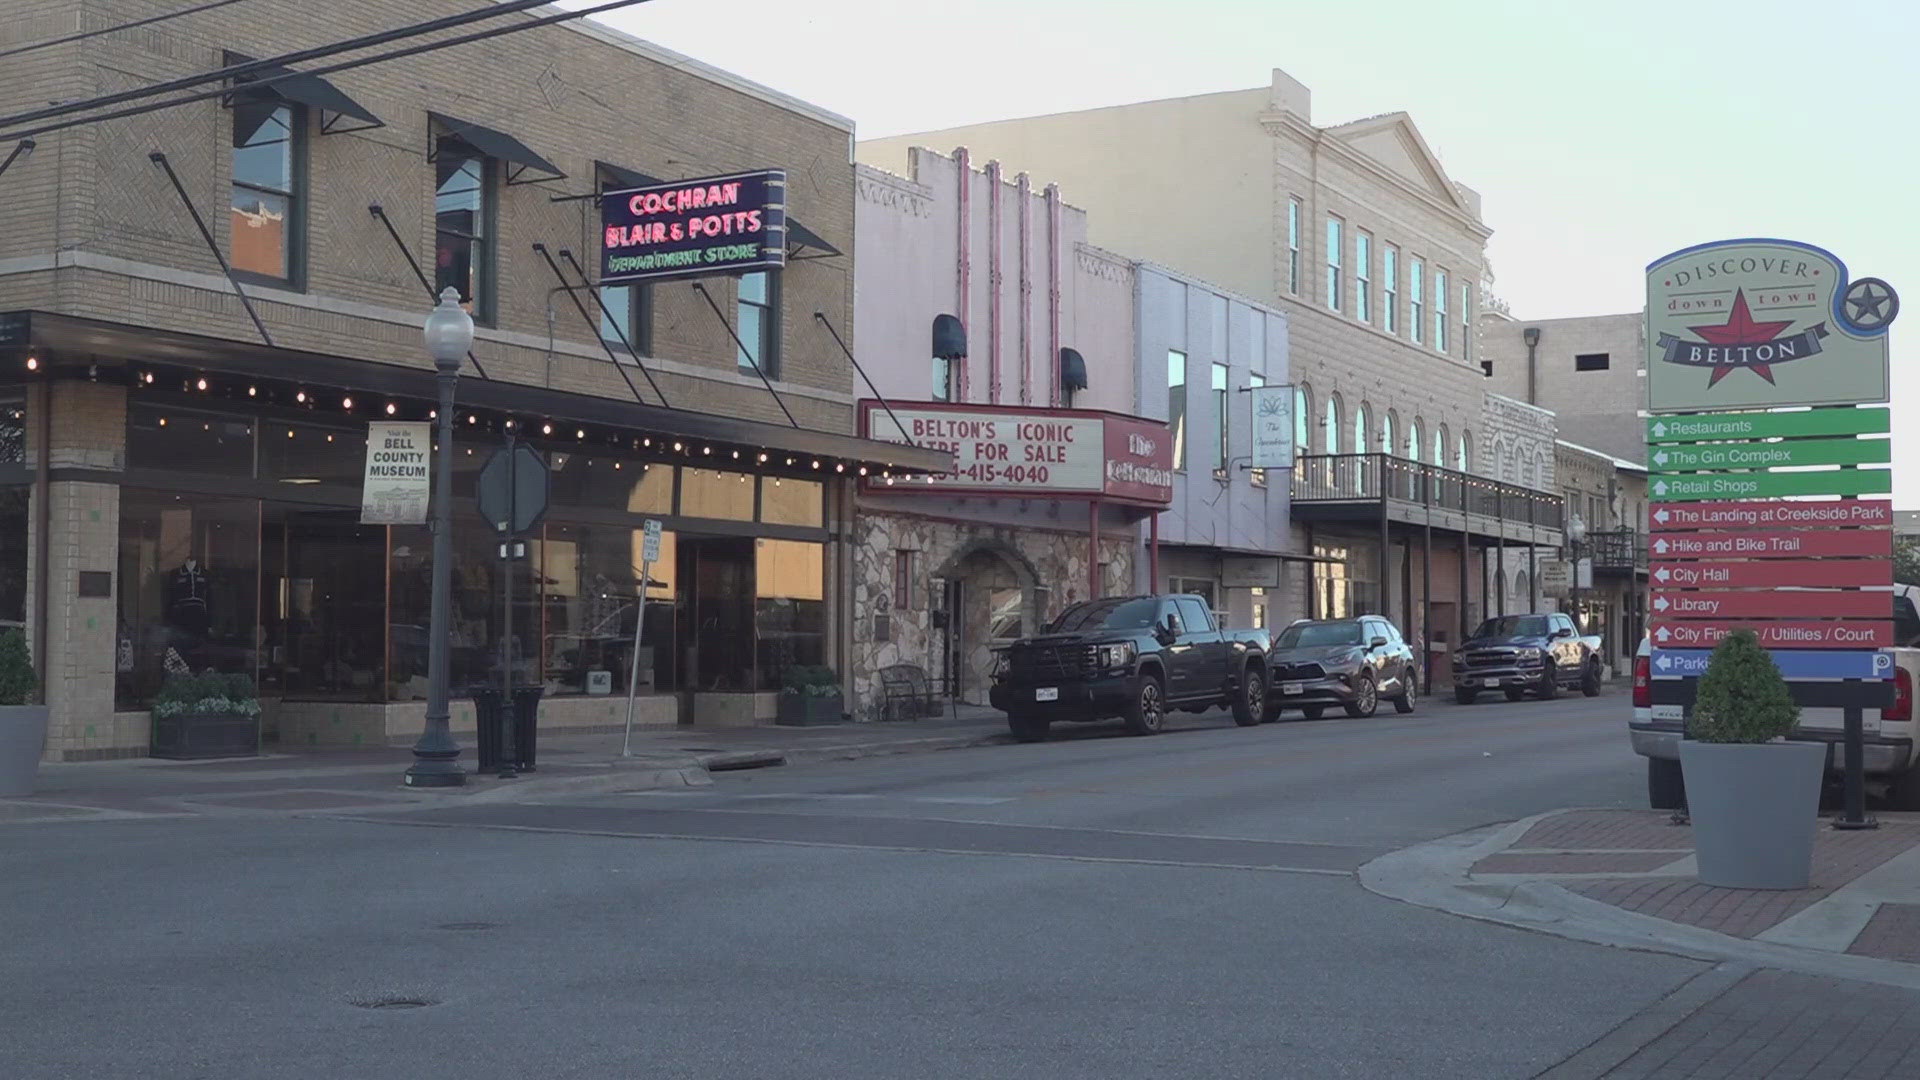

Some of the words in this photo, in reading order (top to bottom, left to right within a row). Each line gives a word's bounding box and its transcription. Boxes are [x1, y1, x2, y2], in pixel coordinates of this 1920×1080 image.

[629, 182, 741, 216] COCHRAN
[605, 222, 667, 249] BLAIR
[670, 223, 684, 241] &
[688, 210, 762, 240] POTTS
[608, 249, 702, 273] DEPARTMENT
[704, 243, 760, 264] STORE
[1675, 257, 1809, 287] DISCOVER
[1668, 297, 1723, 311] down
[1758, 291, 1816, 305] town
[1690, 340, 1796, 363] BELTON
[913, 419, 996, 439] BELTON'S
[1016, 423, 1074, 443] ICONIC
[1671, 420, 1752, 434] Restaurants
[384, 438, 415, 449] BELL
[373, 452, 424, 463] COUNTY
[975, 442, 1008, 461] FOR
[1024, 445, 1067, 463] SALE
[1671, 451, 1697, 464] The
[1701, 450, 1725, 463] Gin
[1729, 449, 1791, 465] Complex
[369, 465, 426, 477] MUSEUM
[1671, 480, 1709, 494] Retail
[1713, 479, 1757, 495] Shops
[1673, 509, 1699, 522] The
[1702, 508, 1757, 524] Landing
[1760, 509, 1774, 521] at
[1776, 506, 1848, 521] Creekside
[1851, 506, 1884, 519] Park
[1672, 538, 1702, 552] Hike
[1706, 538, 1732, 551] and
[1736, 538, 1766, 551] Bike
[1770, 537, 1800, 550] Trail
[1673, 568, 1699, 583] City
[1703, 568, 1729, 581] Hall
[1673, 598, 1719, 613] Library
[1674, 628, 1700, 643] City
[1704, 627, 1759, 641] Fina
[1762, 628, 1768, 640] /
[1772, 628, 1822, 641] Utilities
[1825, 628, 1831, 640] /
[1834, 627, 1875, 641] Court
[1674, 656, 1709, 670] Parki
